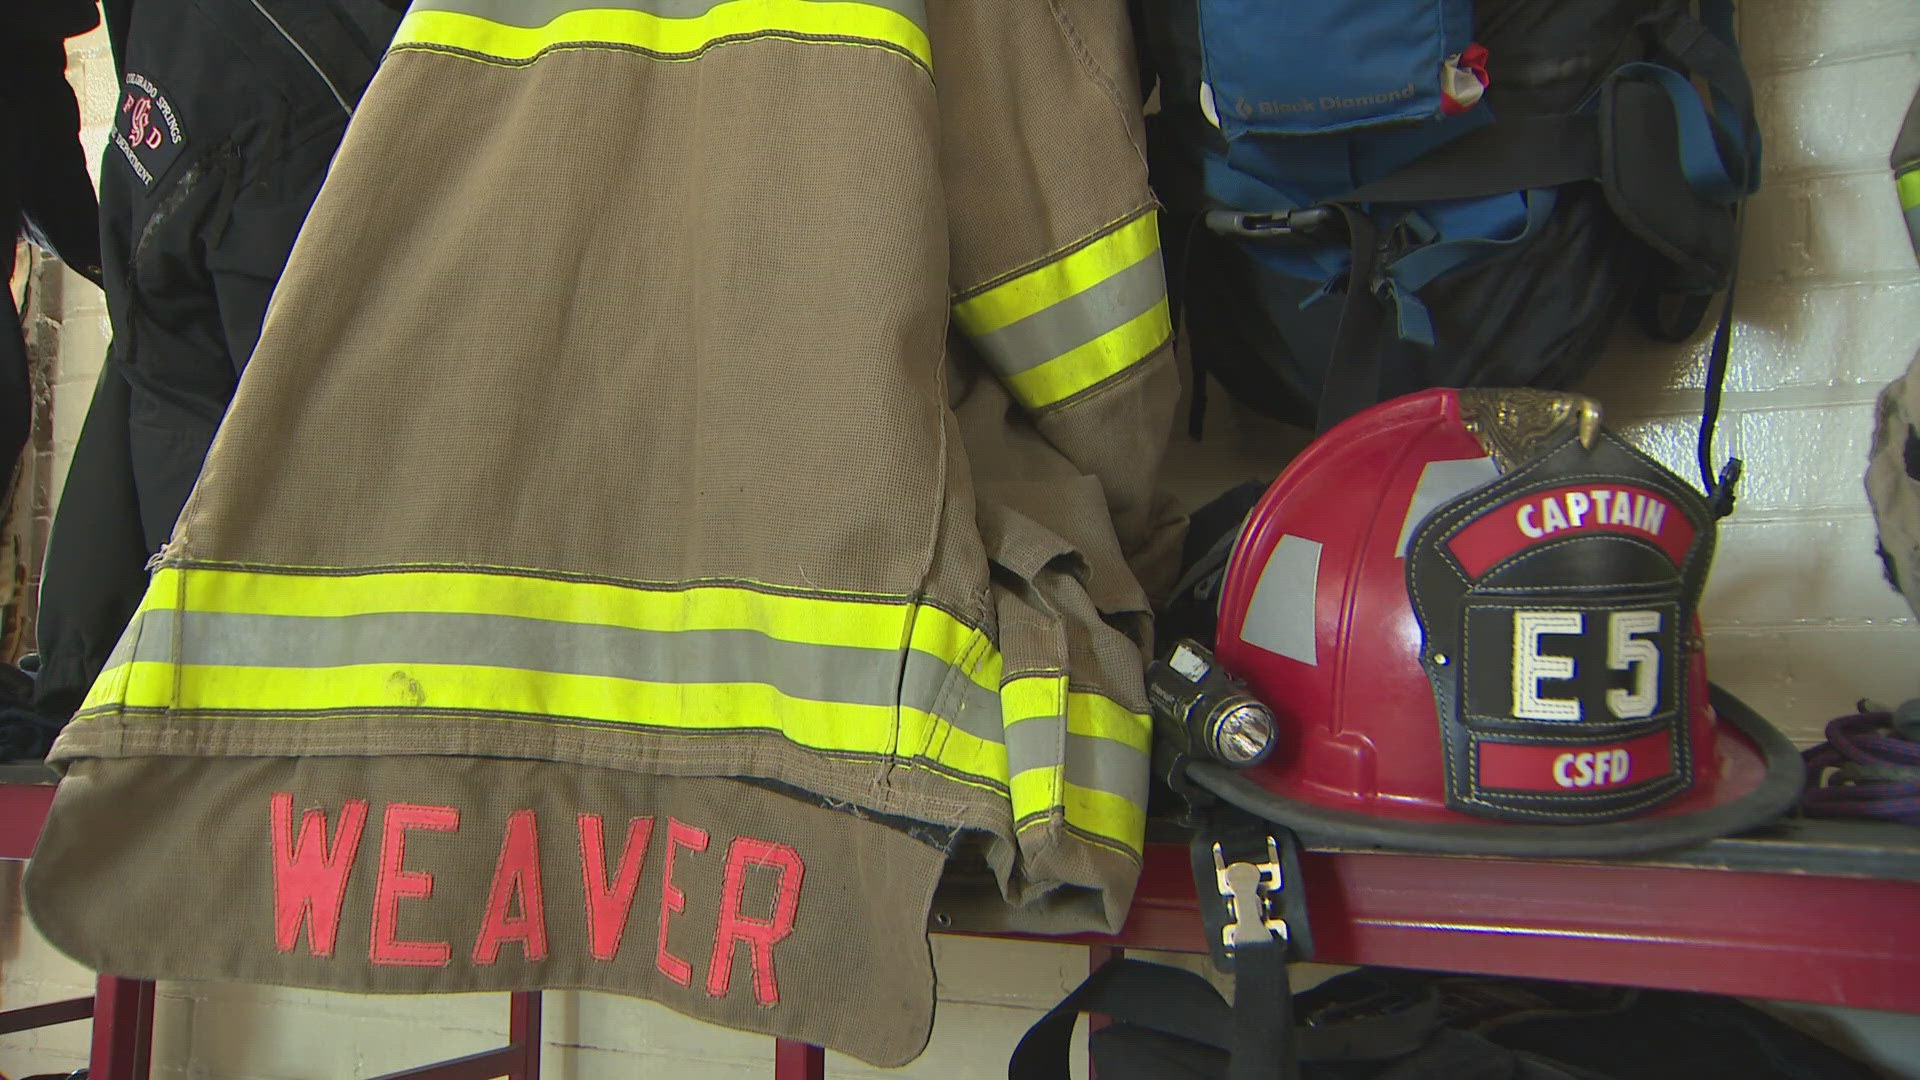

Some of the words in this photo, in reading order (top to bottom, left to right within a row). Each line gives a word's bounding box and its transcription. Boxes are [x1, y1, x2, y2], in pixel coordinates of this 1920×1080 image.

[156, 96, 182, 144] SPRINGS
[1259, 99, 1315, 114] Black
[1319, 83, 1416, 110] Diamond
[116, 134, 153, 185] DEPARTMENT
[146, 127, 162, 149] D
[1517, 490, 1666, 537] CAPTAIN
[1513, 610, 1585, 720] E
[1607, 611, 1661, 718] 5
[1553, 750, 1629, 787] CSFD
[270, 792, 804, 1007] WEAVER
